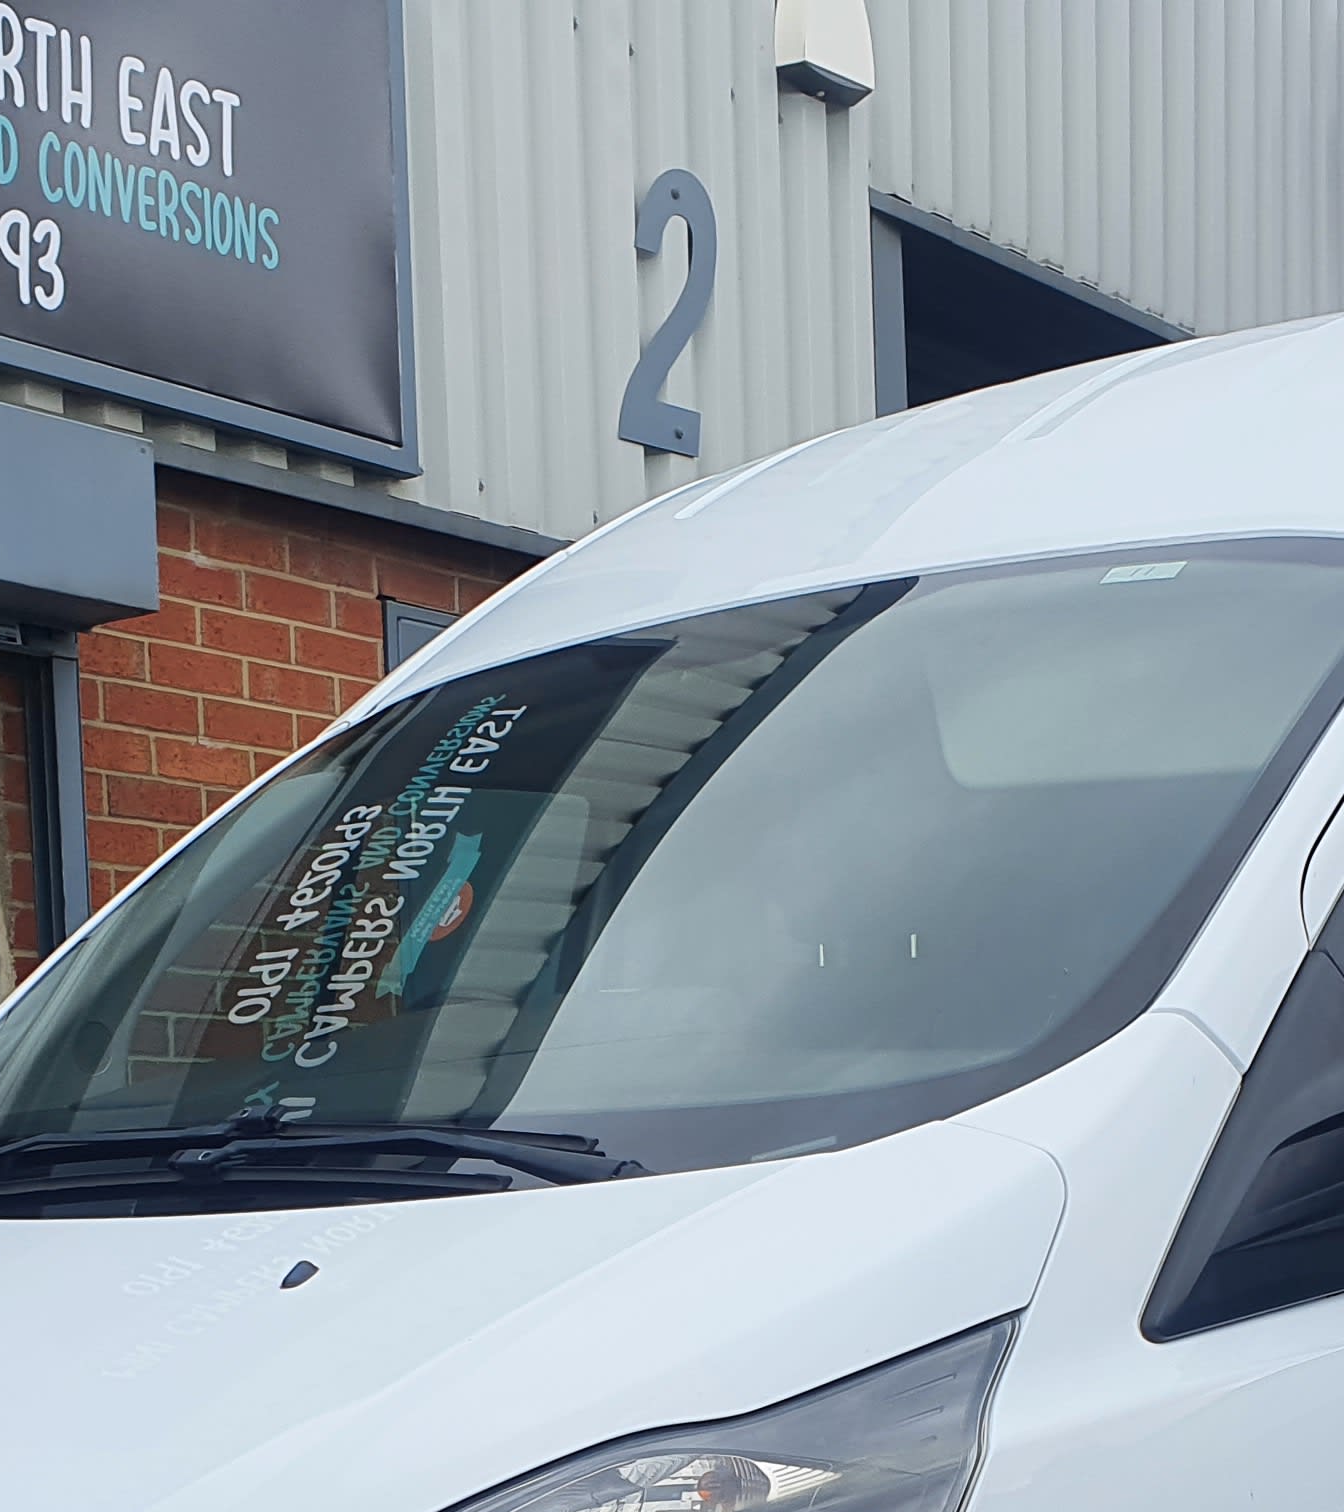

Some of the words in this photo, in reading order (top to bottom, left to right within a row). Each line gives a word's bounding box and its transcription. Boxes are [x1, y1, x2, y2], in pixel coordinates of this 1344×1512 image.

[118, 56, 241, 177] EAST
[38, 130, 281, 271] CONVERSIONS
[618, 168, 718, 458] 2
